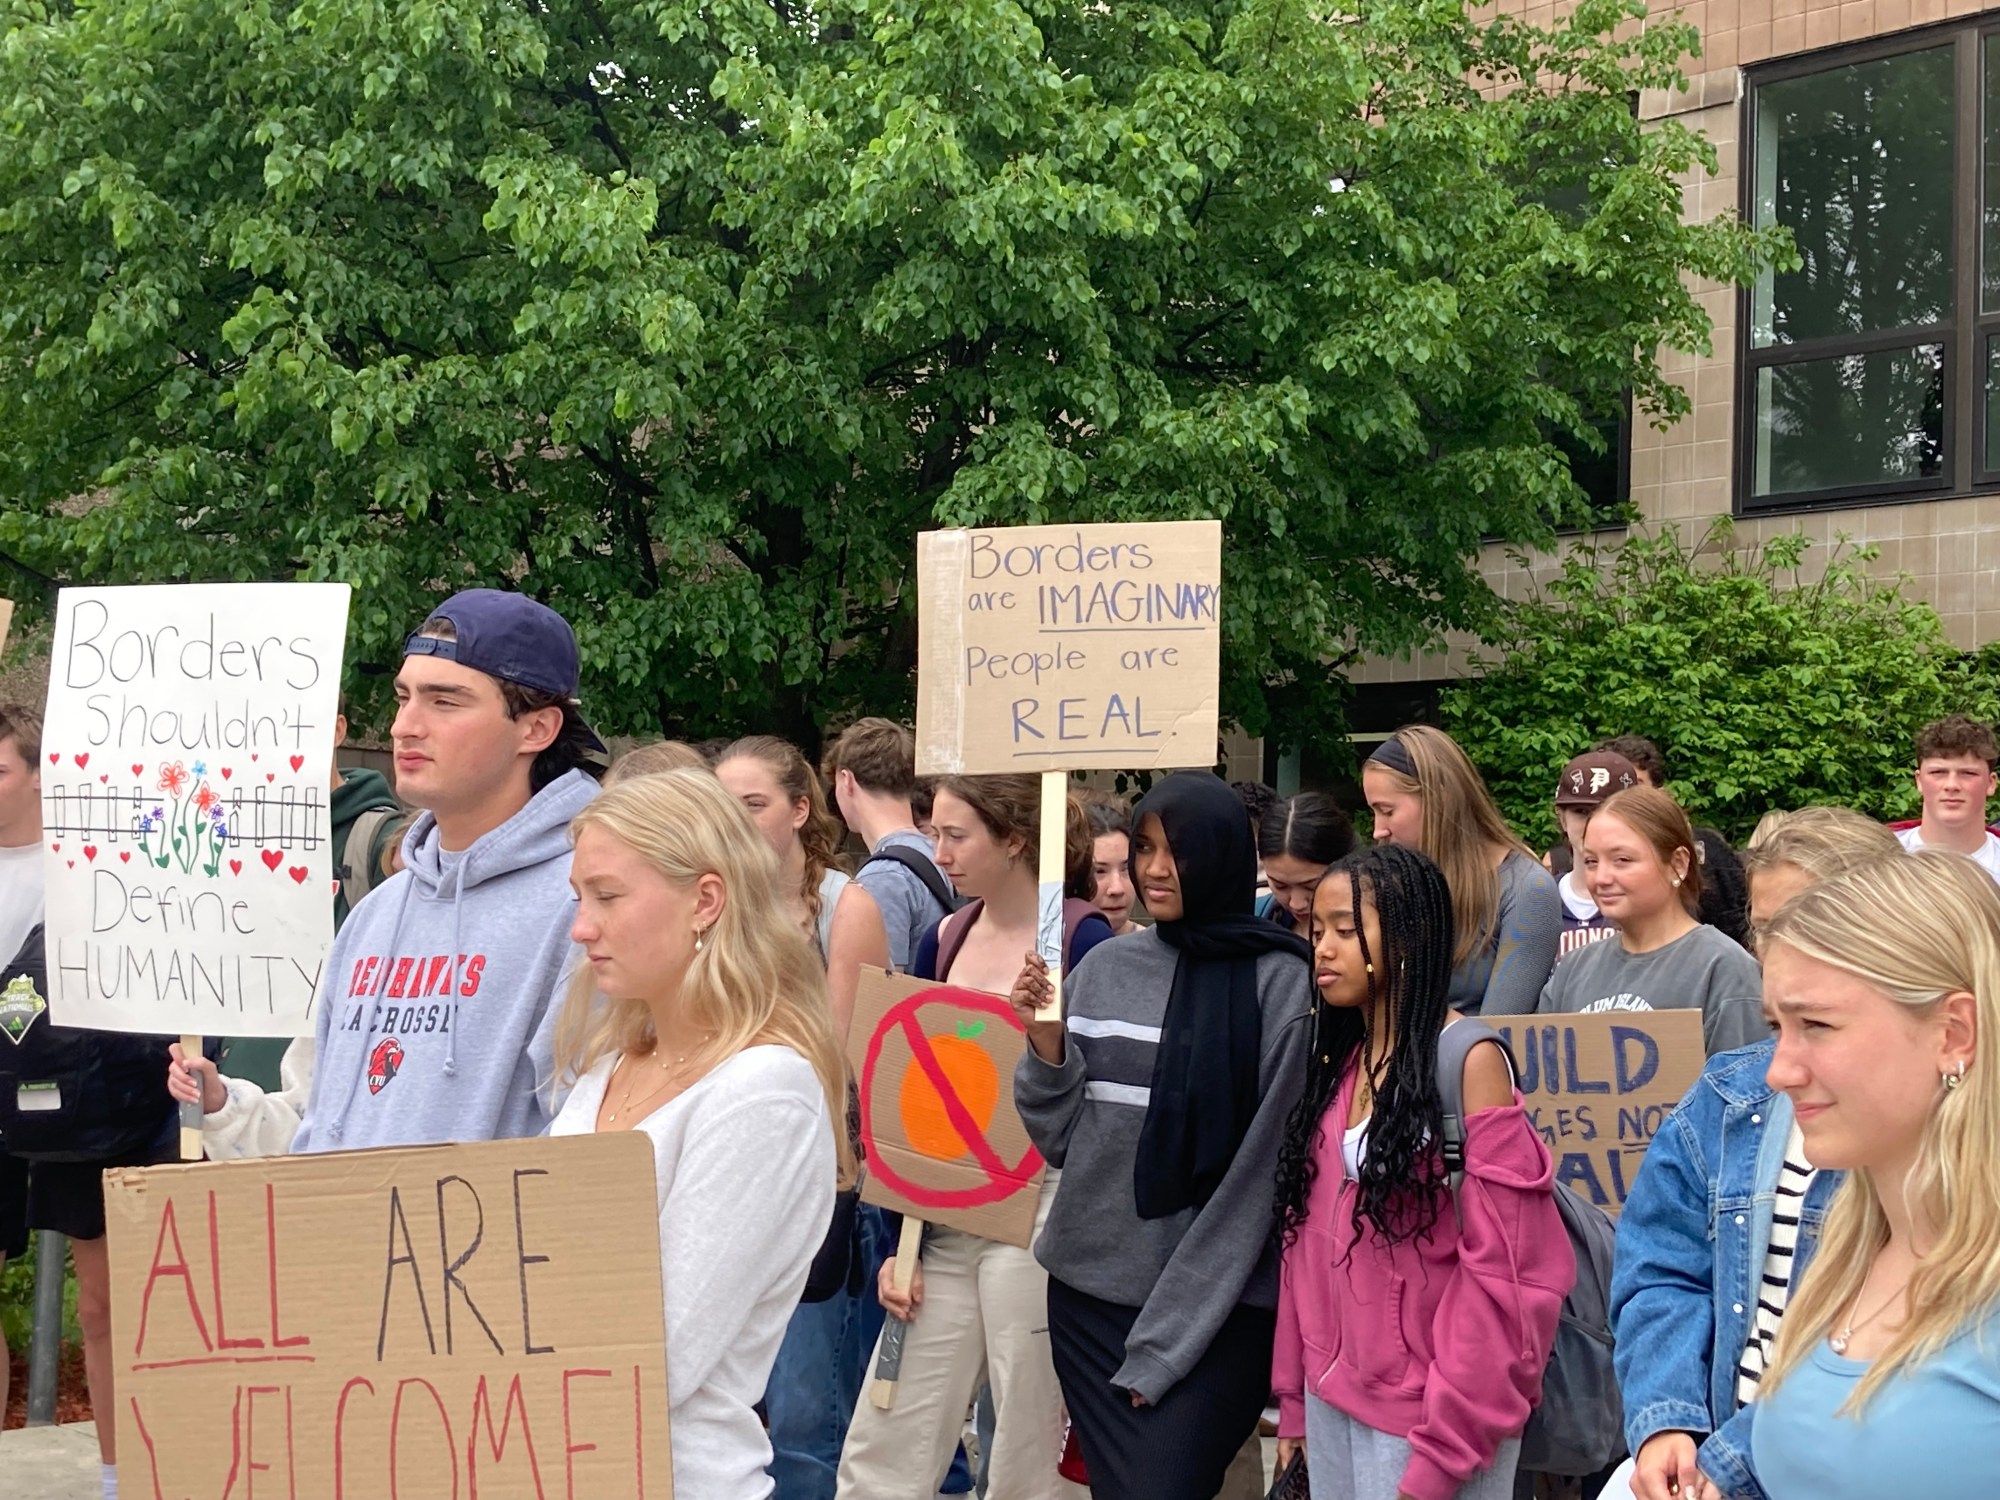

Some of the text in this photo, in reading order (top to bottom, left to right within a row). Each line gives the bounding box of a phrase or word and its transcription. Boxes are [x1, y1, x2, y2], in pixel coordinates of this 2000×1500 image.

[970, 531, 1153, 579] Borders
[968, 580, 1221, 624] are IMAGINARY
[66, 600, 319, 689] Borders
[966, 642, 1179, 687] People are
[1012, 693, 1177, 743] REAL.
[92, 870, 255, 934] Define
[58, 938, 324, 1020] HUMANITY
[136, 1169, 555, 1361] ALL ARE
